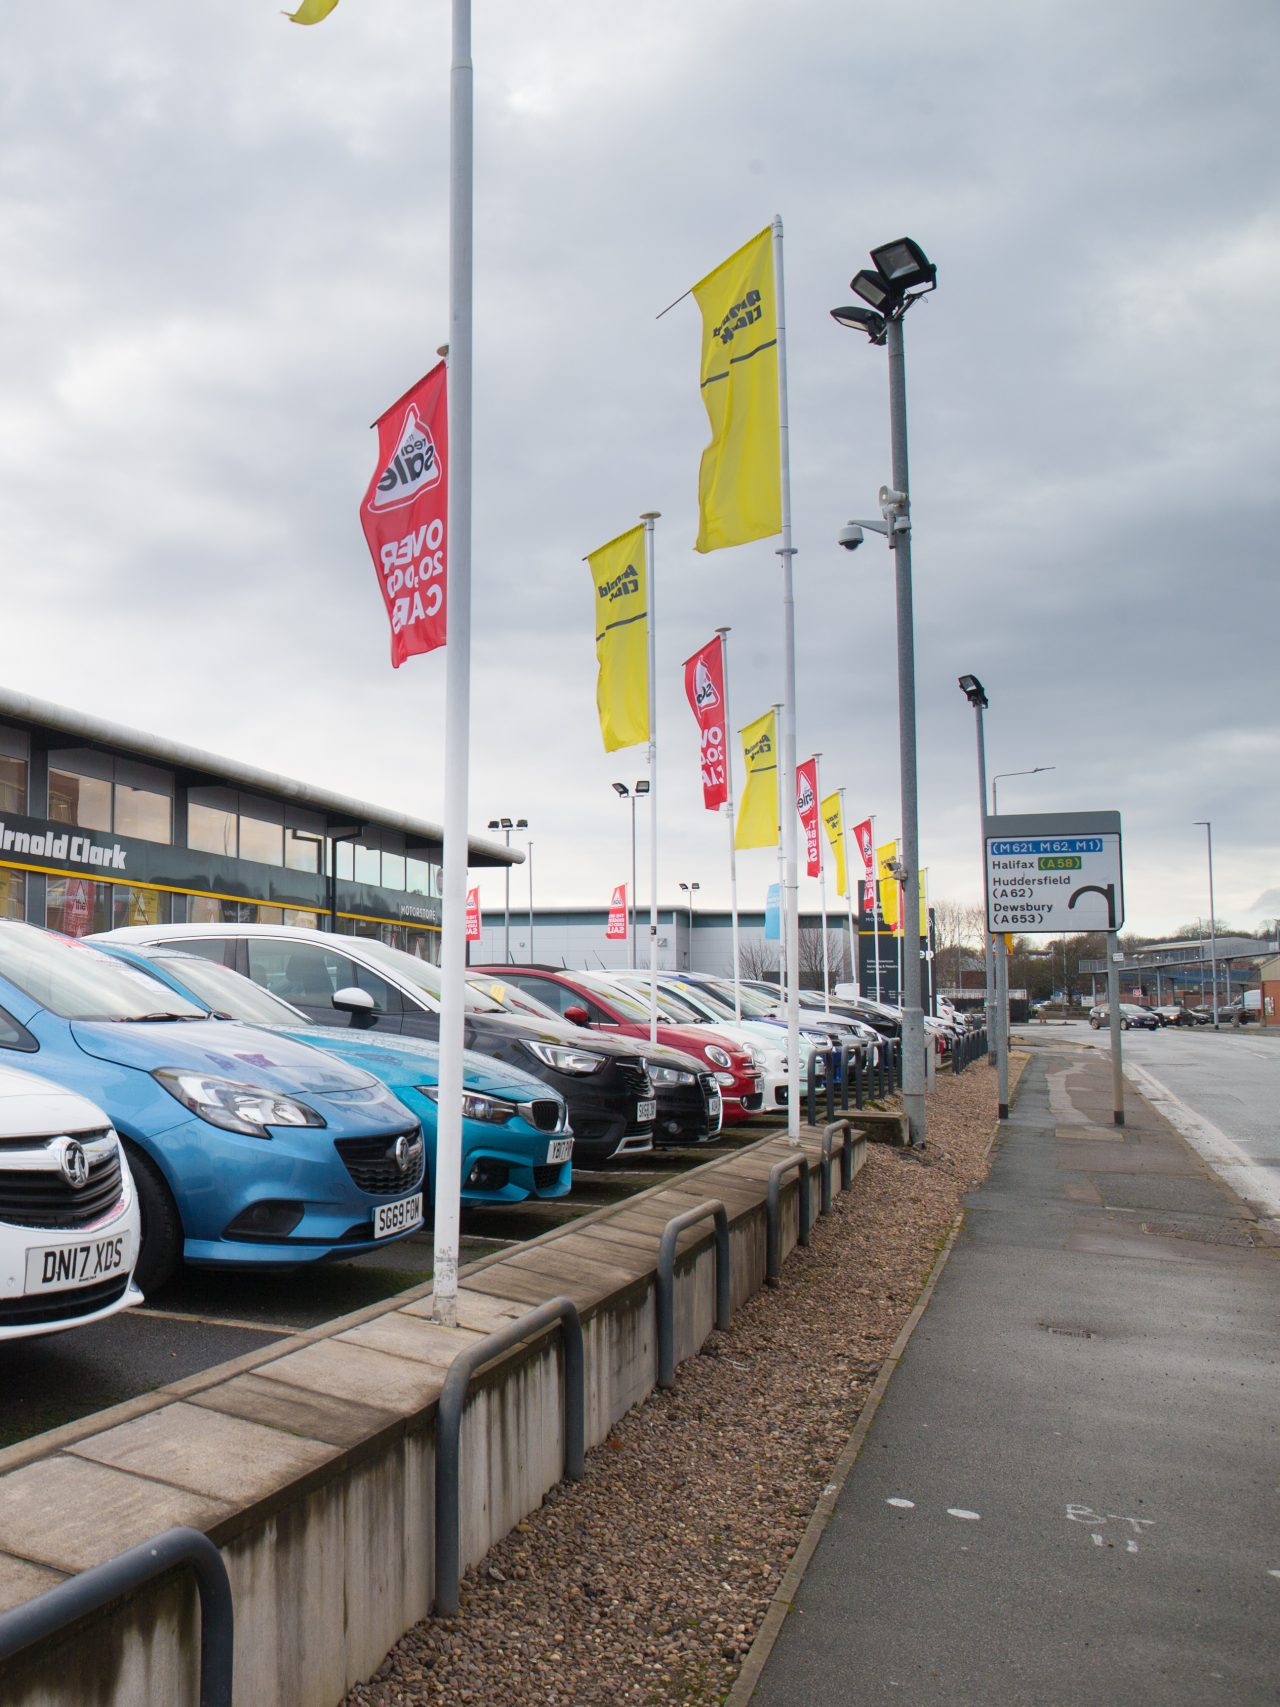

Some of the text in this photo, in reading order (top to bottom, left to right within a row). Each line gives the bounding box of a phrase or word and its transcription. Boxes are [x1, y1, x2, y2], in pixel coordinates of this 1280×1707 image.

[69, 836, 127, 870] Clark
[992, 861, 1034, 869] Halifax
[992, 876, 1070, 886] Huddersfield
[993, 903, 1053, 913] Dewsbury
[379, 1203, 404, 1231] SG69
[42, 1237, 123, 1283] DN17 XDS
